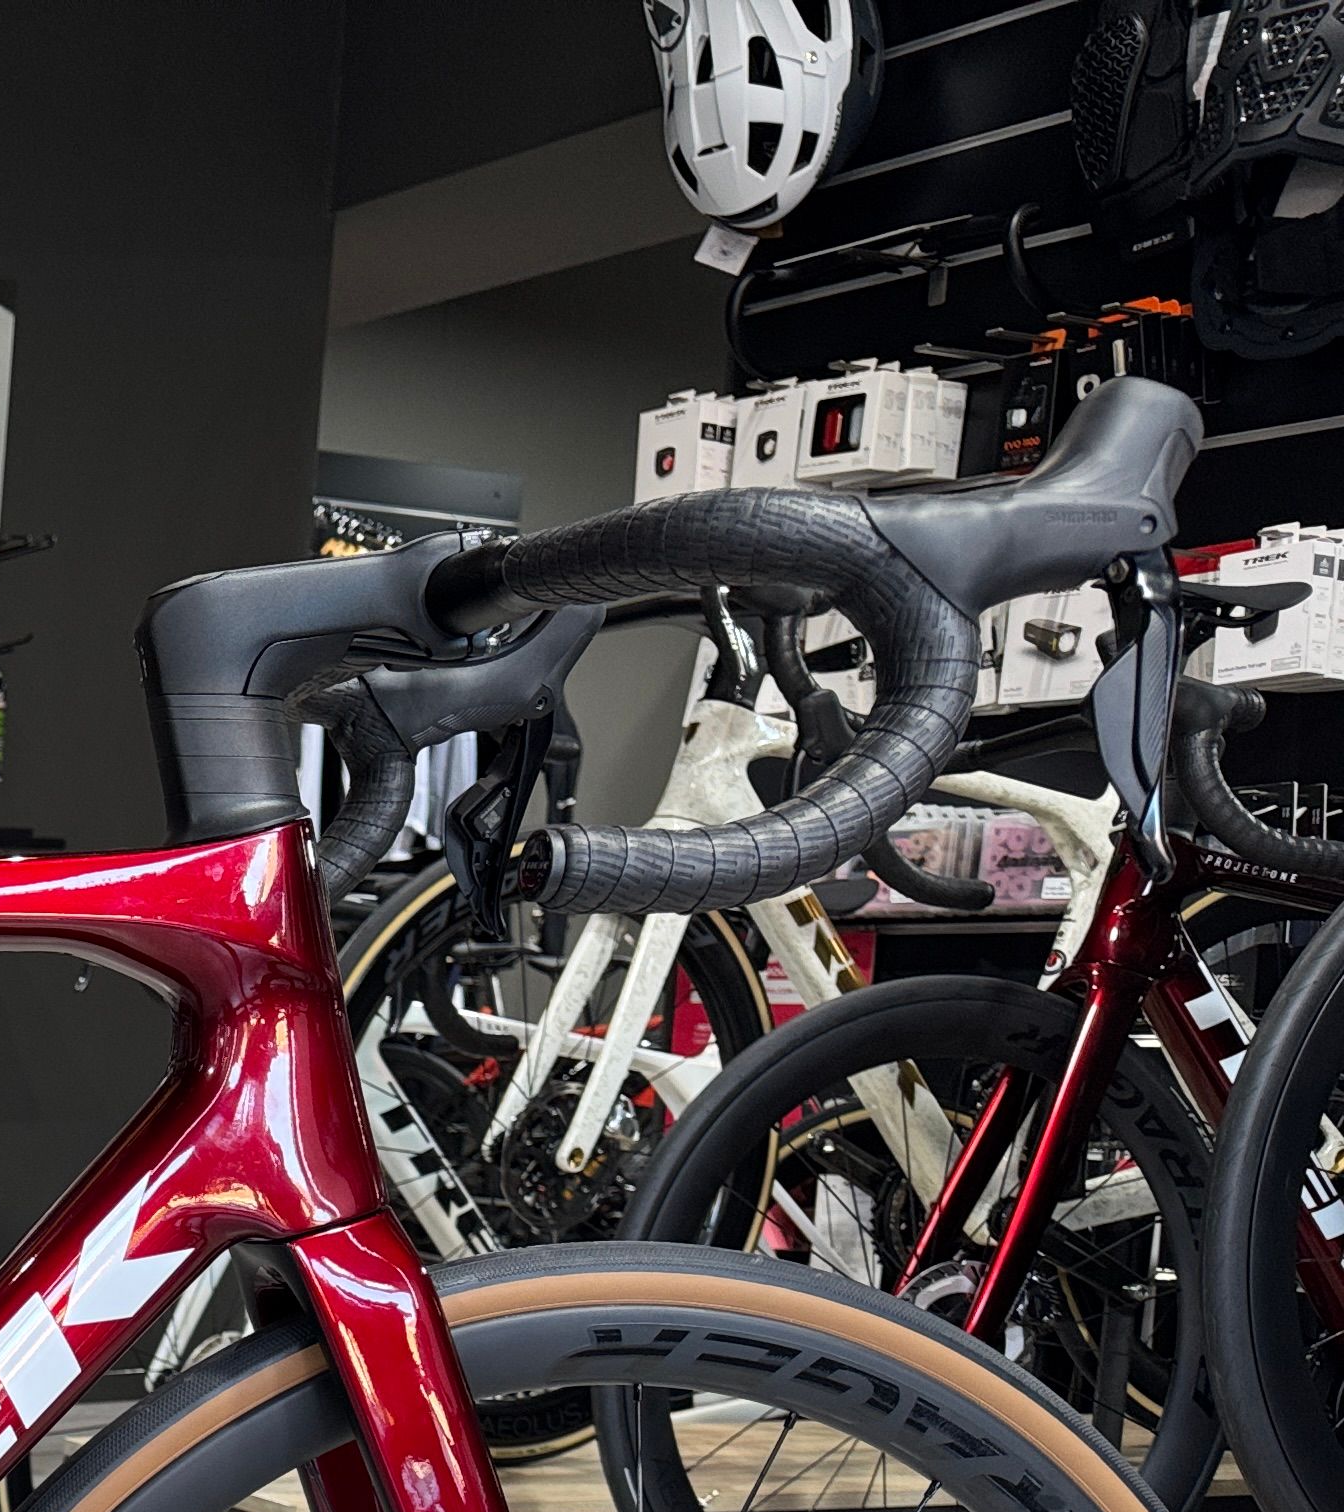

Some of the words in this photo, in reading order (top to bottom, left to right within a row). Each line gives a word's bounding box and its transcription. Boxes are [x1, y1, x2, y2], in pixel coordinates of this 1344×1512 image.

[1243, 551, 1290, 567] TREK
[1205, 854, 1269, 878] PROJECT
[1269, 868, 1300, 884] ONE
